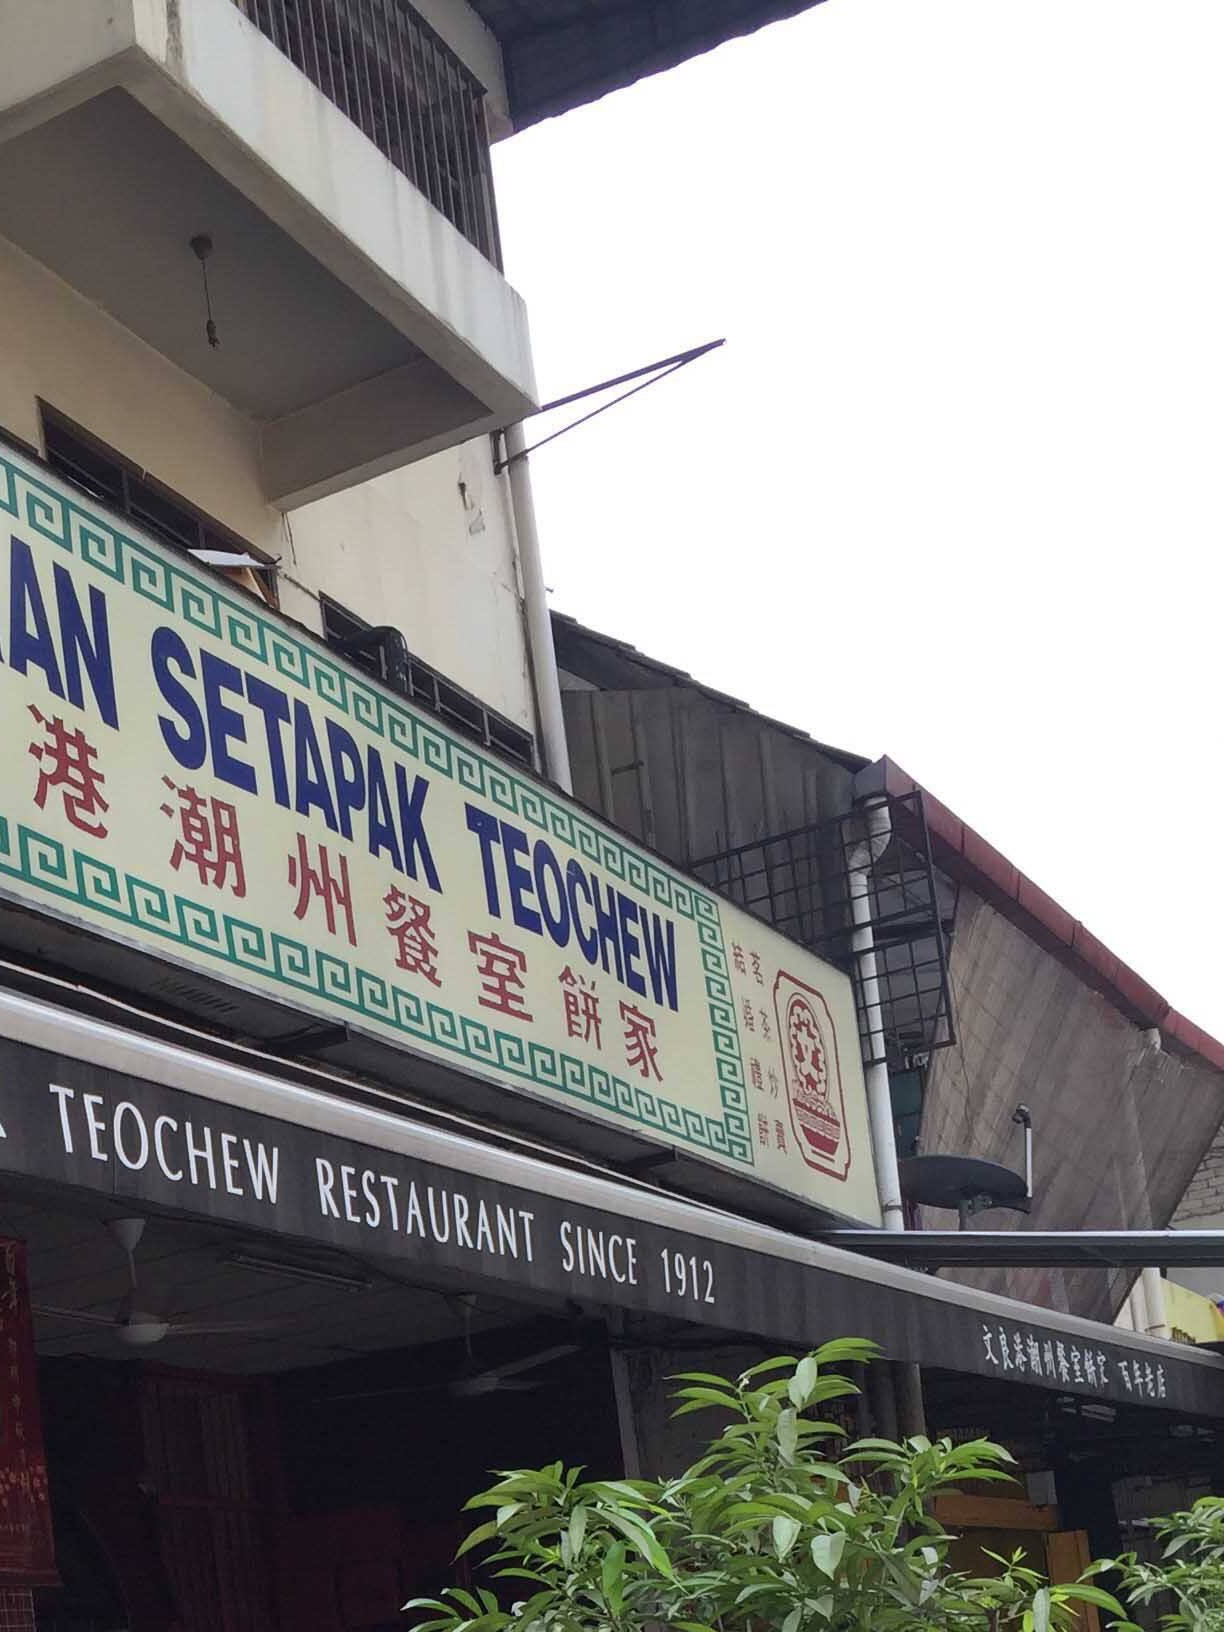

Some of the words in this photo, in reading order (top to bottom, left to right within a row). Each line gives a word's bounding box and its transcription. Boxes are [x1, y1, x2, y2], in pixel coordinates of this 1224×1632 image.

[151, 626, 442, 893] SETAPAK
[465, 803, 679, 1012] TEOCHEW
[49, 1085, 280, 1206] TEOCHEW
[317, 1159, 535, 1262] RESTAURANT
[560, 1220, 638, 1286] SINCE
[660, 1247, 716, 1305] 1912
